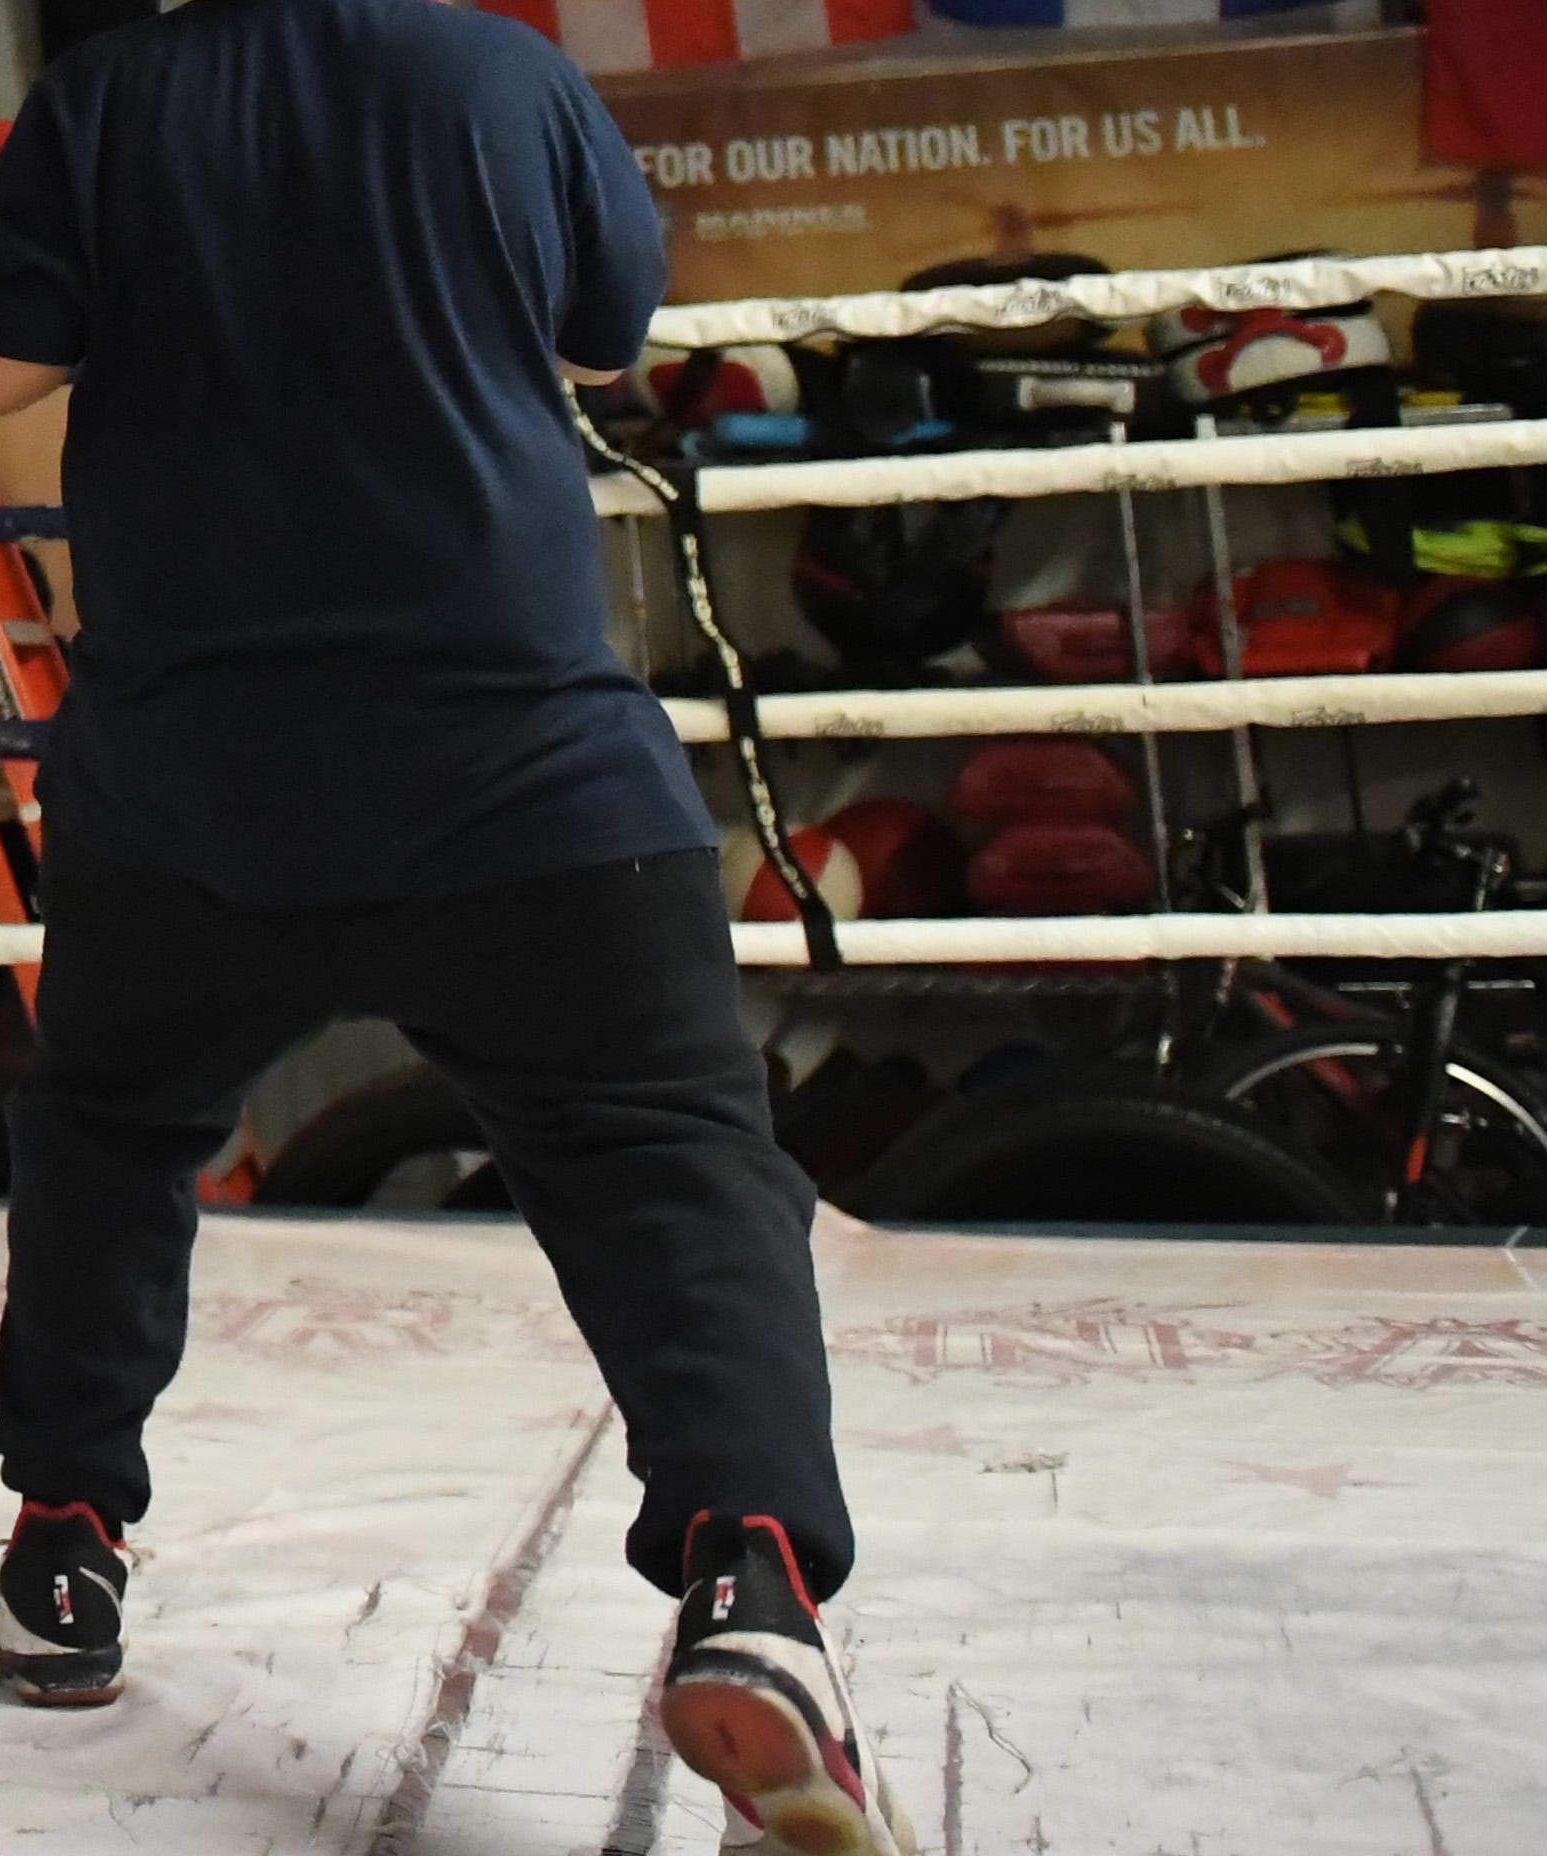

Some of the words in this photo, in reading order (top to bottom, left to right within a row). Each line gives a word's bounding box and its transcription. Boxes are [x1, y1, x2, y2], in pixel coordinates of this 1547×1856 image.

[638, 143, 715, 190] FOR
[726, 134, 816, 183] OUR
[827, 124, 992, 178] NATION.
[1004, 114, 1091, 166] FOR
[1103, 108, 1163, 159] US
[1176, 103, 1263, 152] ALL.
